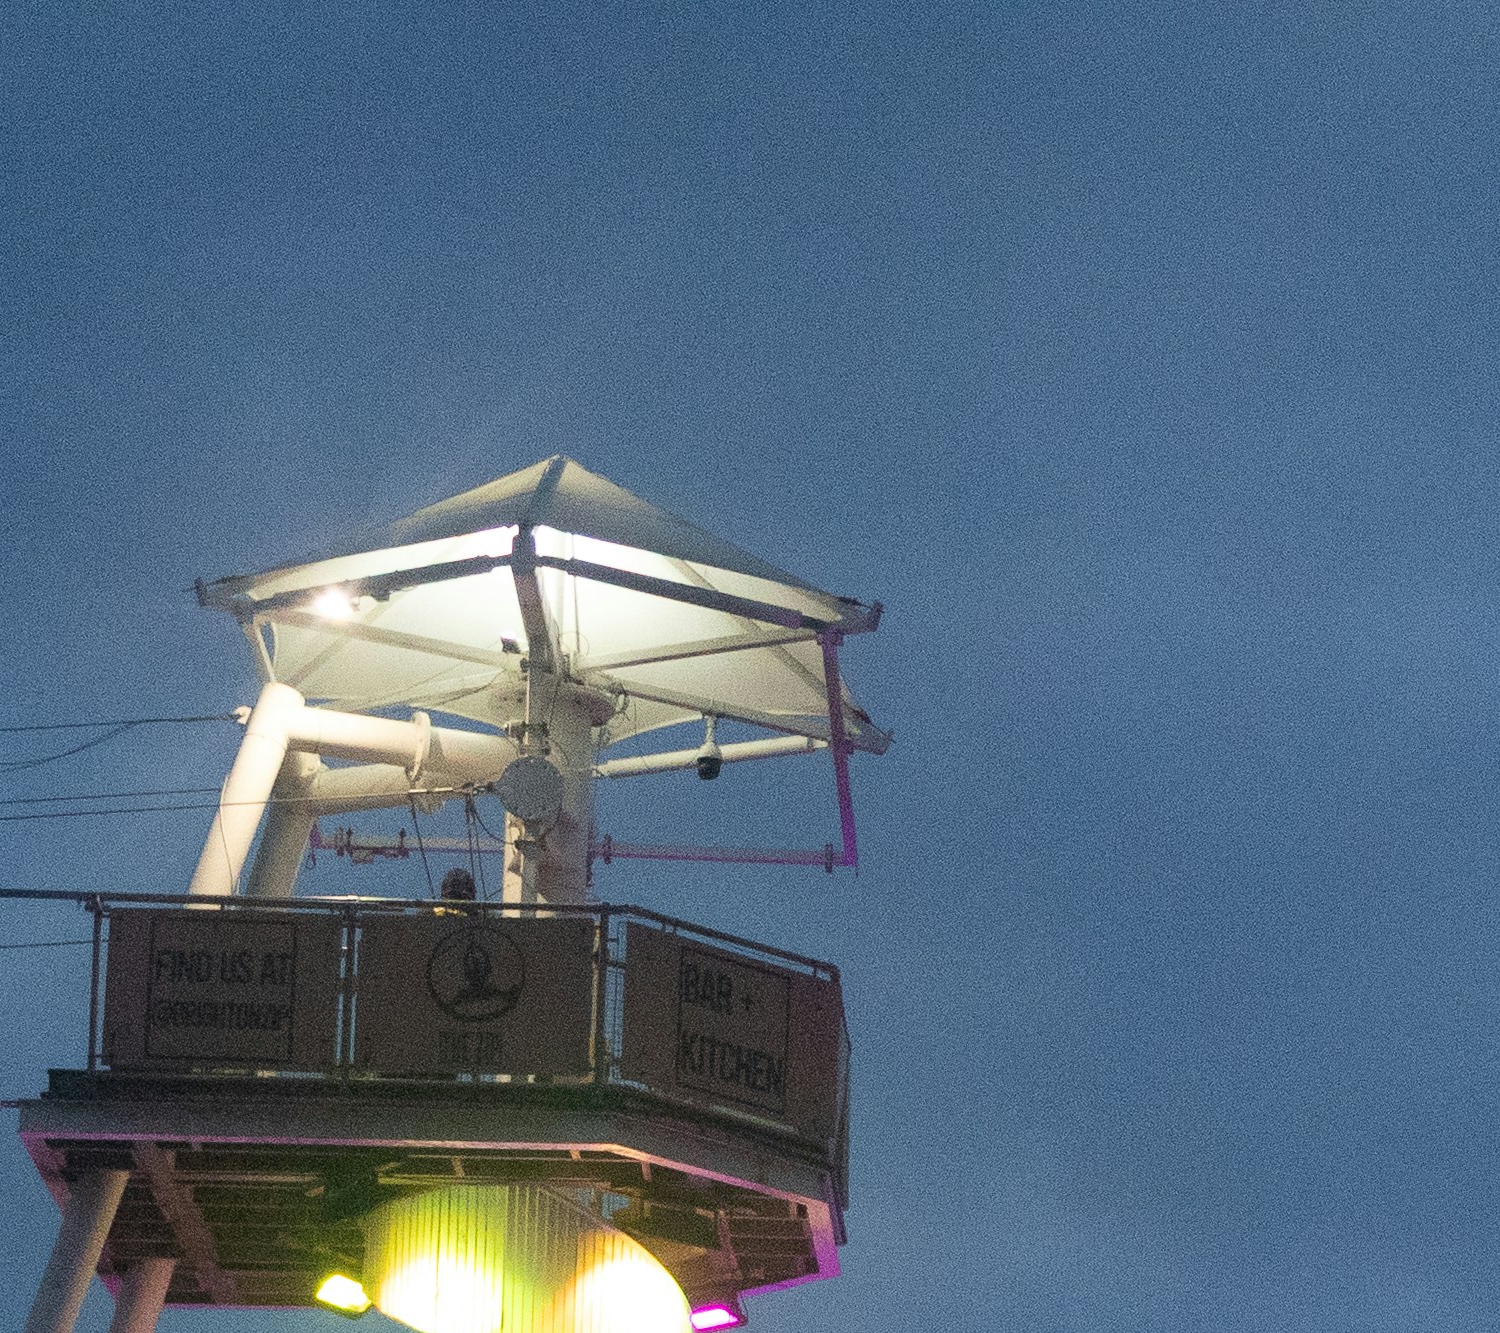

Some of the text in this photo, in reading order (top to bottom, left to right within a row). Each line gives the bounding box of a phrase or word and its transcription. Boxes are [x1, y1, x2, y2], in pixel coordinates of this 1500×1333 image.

[155, 949, 293, 986] FIND US AT
[682, 963, 733, 1015] BAR
[680, 1030, 784, 1098] KITCHEN
